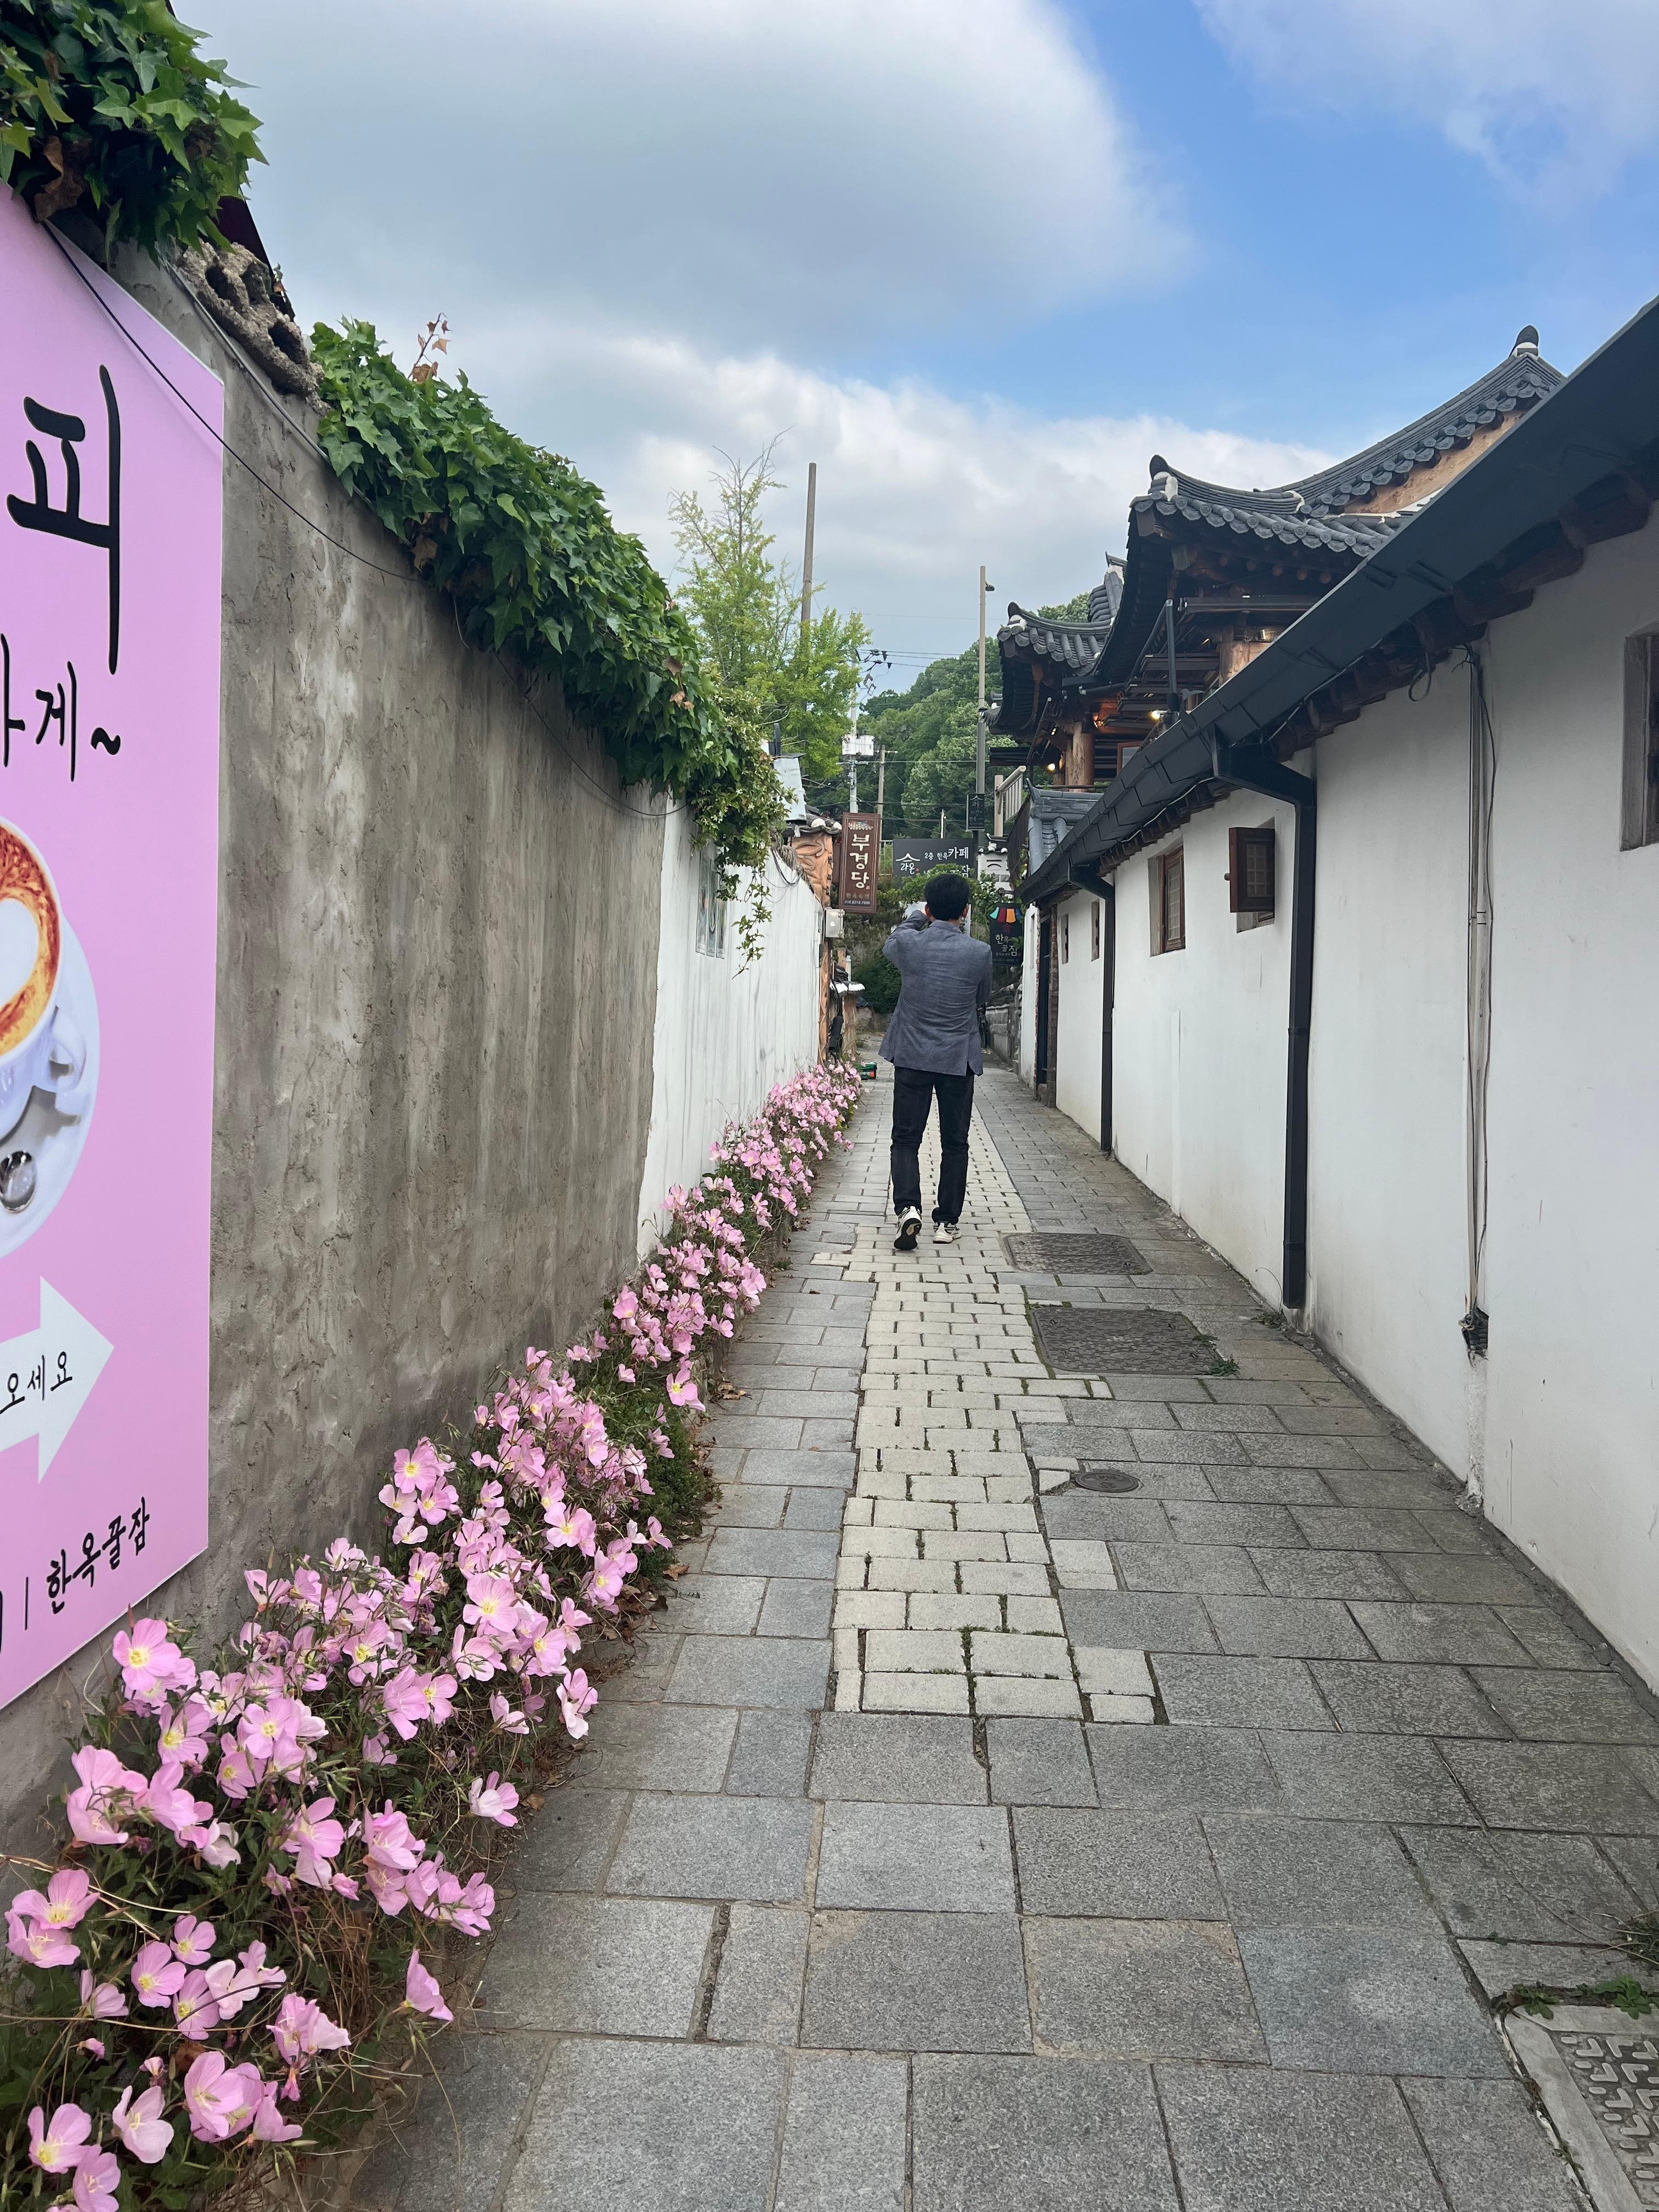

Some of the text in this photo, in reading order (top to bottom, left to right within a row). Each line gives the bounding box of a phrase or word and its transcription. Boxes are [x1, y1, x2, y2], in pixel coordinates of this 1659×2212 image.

[7, 364, 121, 675] 피
[850, 834, 870, 889] 부경당
[900, 862, 915, 874] 라온
[924, 852, 933, 860] 2층
[995, 934, 1009, 944] 한옥
[0, 1351, 72, 1414] 오세요
[46, 1496, 150, 1615] 한옥꿀잠
